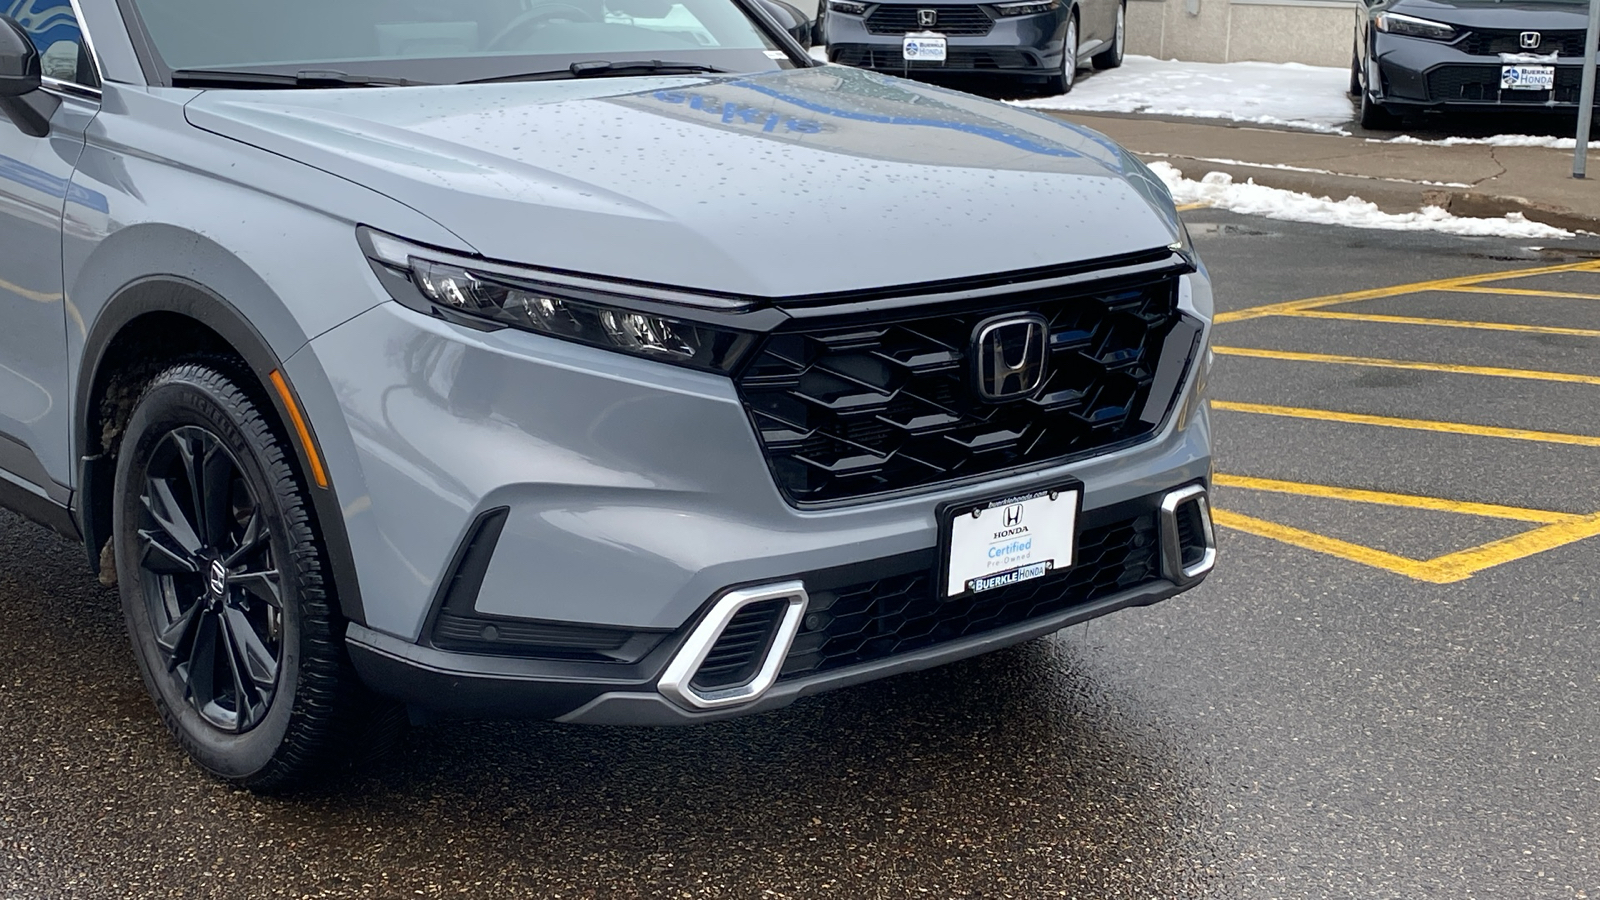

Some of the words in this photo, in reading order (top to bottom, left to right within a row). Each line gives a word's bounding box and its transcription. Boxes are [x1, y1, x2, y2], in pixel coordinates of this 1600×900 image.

[1520, 75, 1553, 84] HONDA
[993, 526, 1029, 539] HONDA
[988, 538, 1032, 558] Certified
[987, 552, 1031, 568] Pre-Owned
[976, 571, 1018, 591] BUERKLE
[1019, 565, 1044, 580] HONDA
